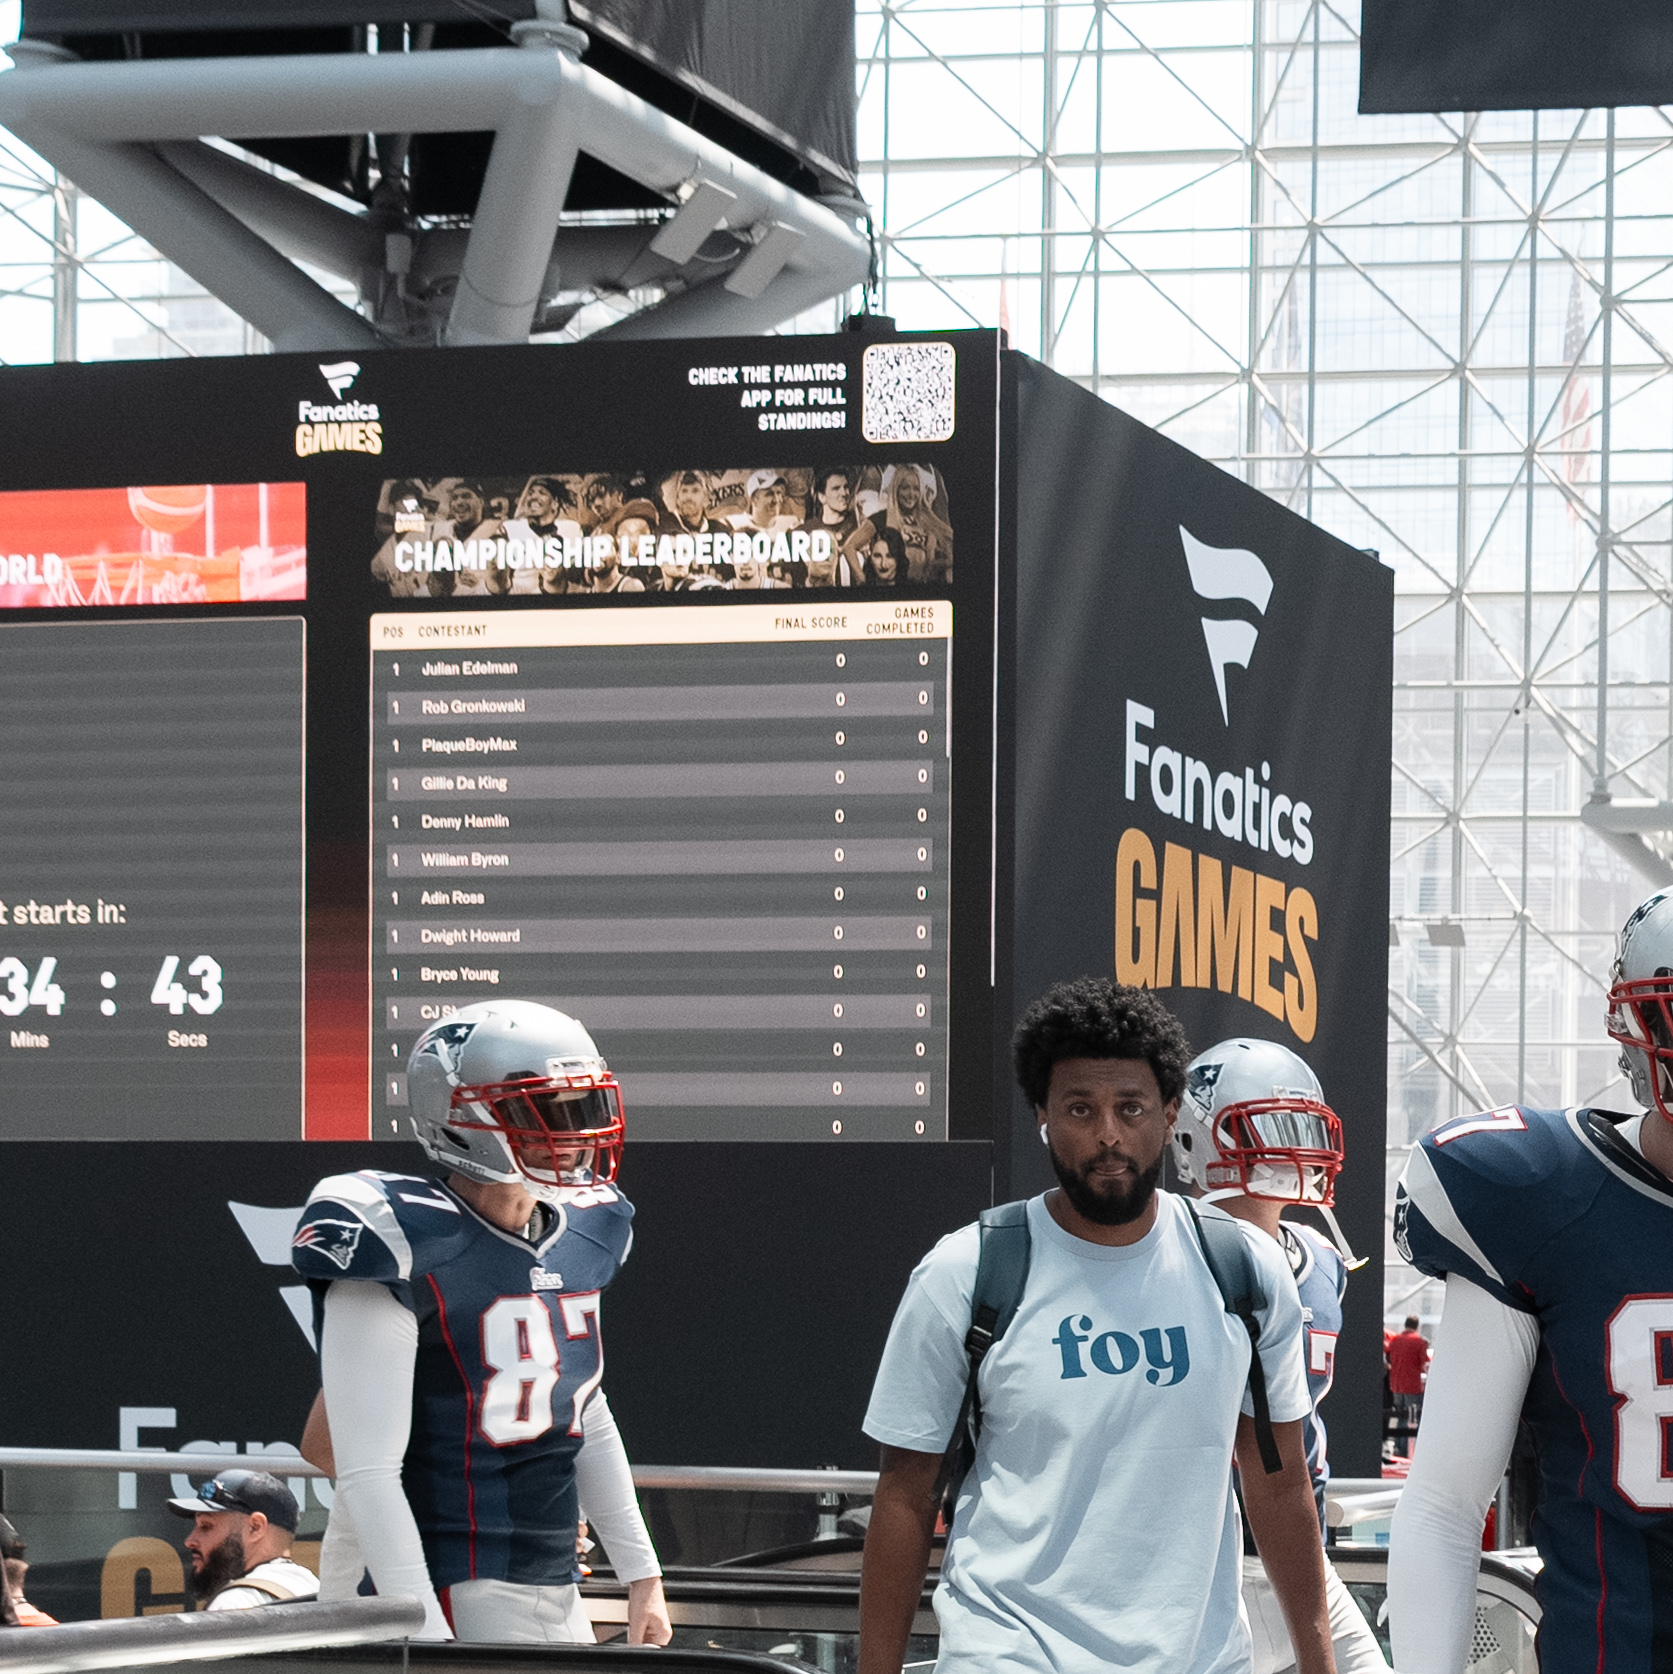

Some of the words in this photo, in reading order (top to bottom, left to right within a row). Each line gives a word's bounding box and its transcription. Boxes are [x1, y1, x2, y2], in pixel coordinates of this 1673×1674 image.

[687, 367, 737, 386] CHECK
[741, 366, 769, 384] THE
[774, 363, 848, 382] FANATICS
[740, 390, 770, 408] APP
[774, 389, 804, 407] FOR
[809, 387, 847, 406] FULL
[298, 400, 380, 422] Fanatics
[757, 412, 848, 431] STANDINGS!
[295, 422, 383, 457] GAMES
[395, 533, 612, 573] CHAMPIONSHIP
[620, 530, 832, 567] LEADERBOARD
[893, 607, 935, 620] GAMES
[382, 626, 405, 639] POS
[417, 624, 488, 638] CONTESTANT
[774, 616, 804, 629] FINAL
[809, 615, 849, 628] SCORE
[866, 620, 935, 635] COMPLETED
[392, 662, 400, 677] 1
[422, 662, 460, 676] Julian
[462, 661, 518, 675] Edelman
[835, 653, 846, 668] 0
[918, 651, 929, 666] 0
[392, 700, 399, 715] 1
[422, 700, 449, 714] Rob
[450, 698, 526, 714] Gronkowski
[835, 692, 846, 707] 0
[918, 690, 928, 705] 0
[392, 738, 399, 753] 1
[422, 737, 517, 754] PlaqueBoyMax
[835, 731, 845, 746] 0
[918, 729, 928, 744] 0
[392, 777, 399, 791] 1
[421, 776, 454, 790] Gillie
[456, 776, 476, 790] Da
[478, 775, 508, 792] King
[835, 769, 845, 784] 0
[917, 768, 928, 783] 0
[1125, 698, 1314, 866] Fanatics
[391, 815, 399, 829] 1
[421, 814, 462, 831] Denny
[464, 814, 510, 828] Hamlin
[834, 808, 845, 823] 0
[917, 807, 927, 822] 0
[392, 852, 399, 867] 1
[421, 853, 469, 867] William
[471, 852, 509, 869] Byron
[834, 847, 845, 862] 0
[917, 847, 927, 862] 0
[391, 891, 399, 905] 1
[421, 891, 450, 905] Adin
[834, 886, 844, 901] 0
[917, 885, 927, 901] 0
[13, 899, 91, 925] starts
[97, 898, 127, 924] in:
[391, 929, 398, 943] 1
[421, 929, 468, 946] Dwight
[470, 928, 521, 943] Howard
[833, 925, 844, 940] 0
[916, 925, 926, 939] 0
[1113, 827, 1320, 1044] GAMES
[0, 956, 66, 1017] 34
[150, 954, 224, 1015] 43
[391, 967, 398, 981] 1
[420, 967, 458, 984] Bryce
[459, 966, 500, 984] Young
[833, 964, 844, 979] 0
[916, 964, 926, 979] 0
[391, 1005, 398, 1019] 1
[833, 1003, 844, 1018] 0
[915, 1002, 926, 1018] 0
[10, 1030, 50, 1049] Mins
[167, 1029, 209, 1048] Secs
[391, 1043, 398, 1057] 1
[832, 1042, 843, 1057] 0
[915, 1042, 925, 1057] 0
[391, 1081, 398, 1095] 1
[832, 1081, 842, 1096] 0
[914, 1081, 925, 1096] 0
[391, 1119, 398, 1133] 1
[832, 1120, 842, 1135] 0
[914, 1120, 925, 1135] 0
[1051, 1313, 1191, 1387] foy
[477, 1289, 604, 1448] 87
